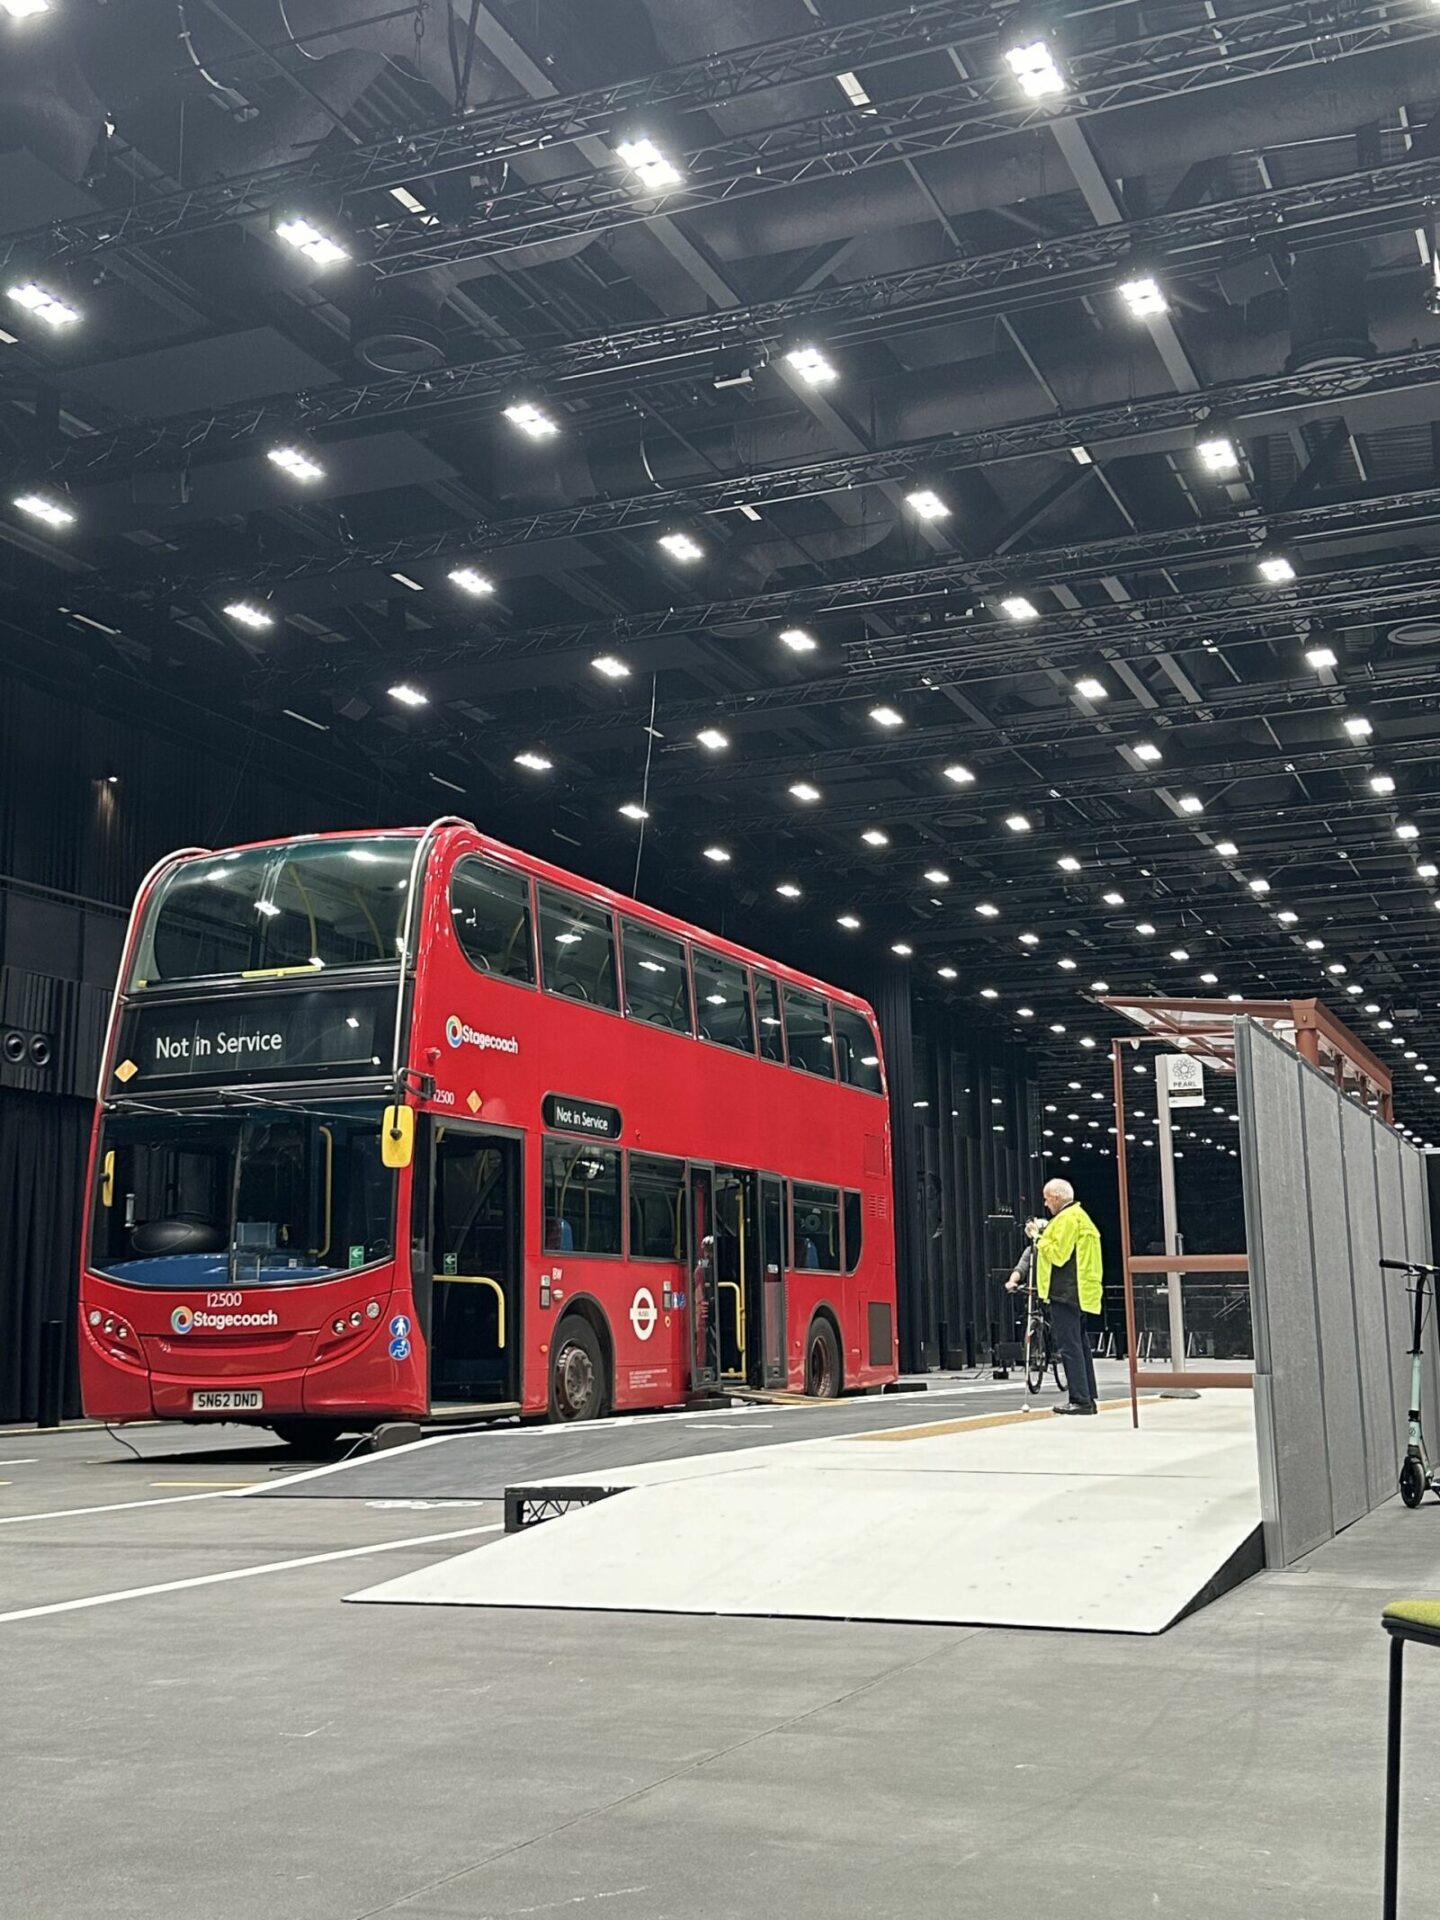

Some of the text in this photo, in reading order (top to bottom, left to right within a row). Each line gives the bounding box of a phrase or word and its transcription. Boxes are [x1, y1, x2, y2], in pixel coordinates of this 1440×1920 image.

[156, 1030, 283, 1059] Not in Service
[462, 1024, 519, 1055] Stagecoach
[1173, 1080, 1197, 1088] PEARL
[556, 1105, 609, 1131] Not in Service
[193, 1309, 278, 1330] Stagecoach
[198, 1393, 258, 1408] SN62 DND
